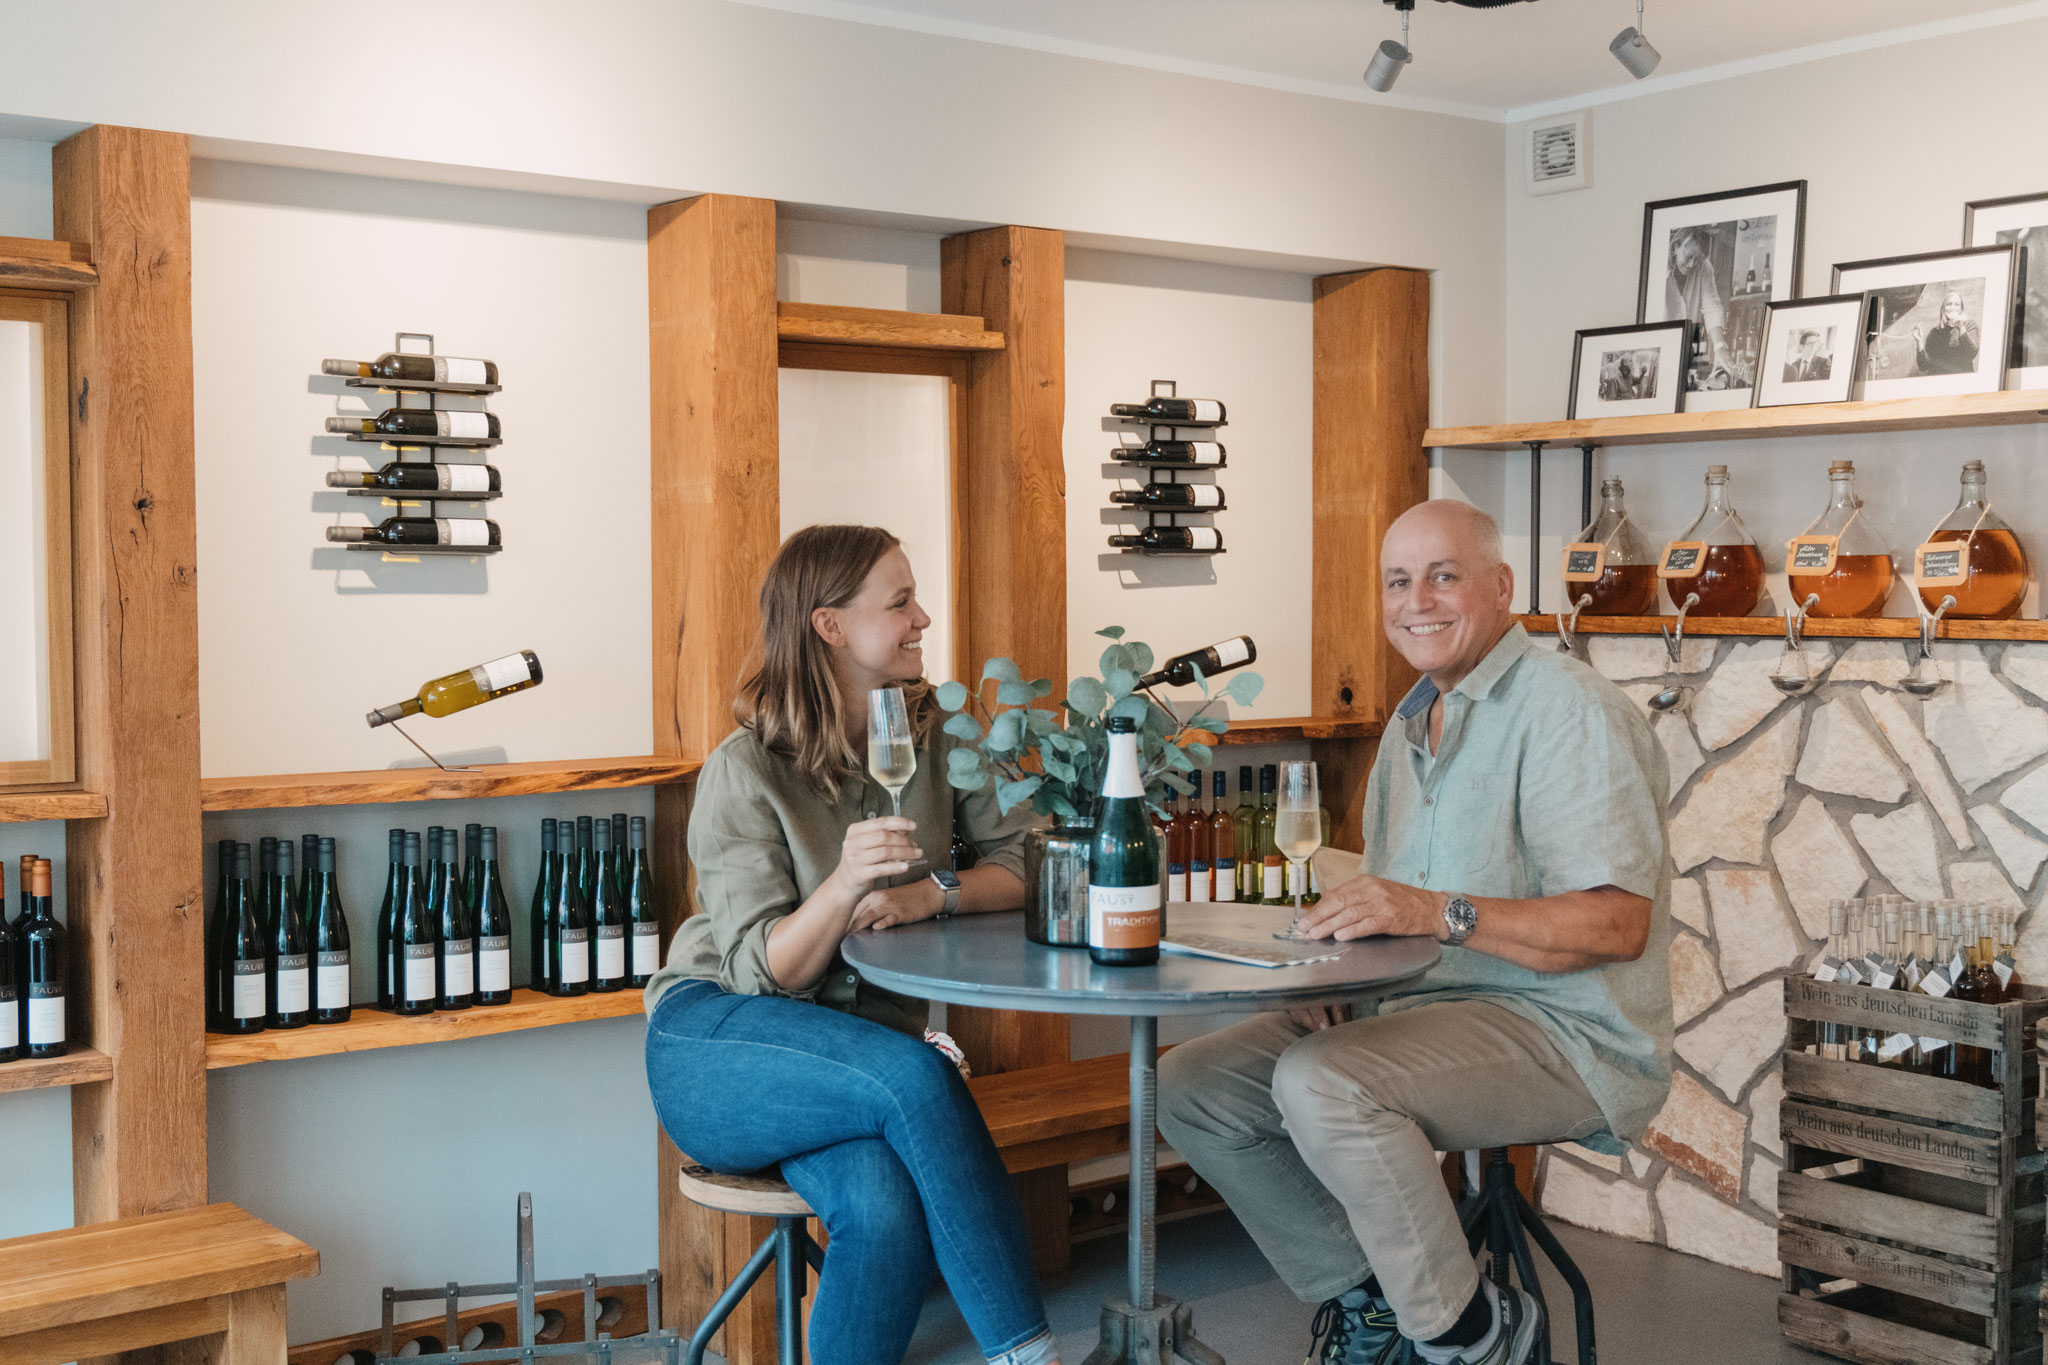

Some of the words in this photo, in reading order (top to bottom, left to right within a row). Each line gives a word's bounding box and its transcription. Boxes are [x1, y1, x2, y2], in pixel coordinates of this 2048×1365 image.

[1801, 983, 1831, 1004] Wein
[1835, 992, 1857, 1008] aus
[1861, 993, 1928, 1019] deutschen
[1797, 1109, 1827, 1131] Wein
[1830, 1120, 1852, 1136] aus
[1857, 1121, 1921, 1151] deutschen
[1925, 1132, 1976, 1161] Landen
